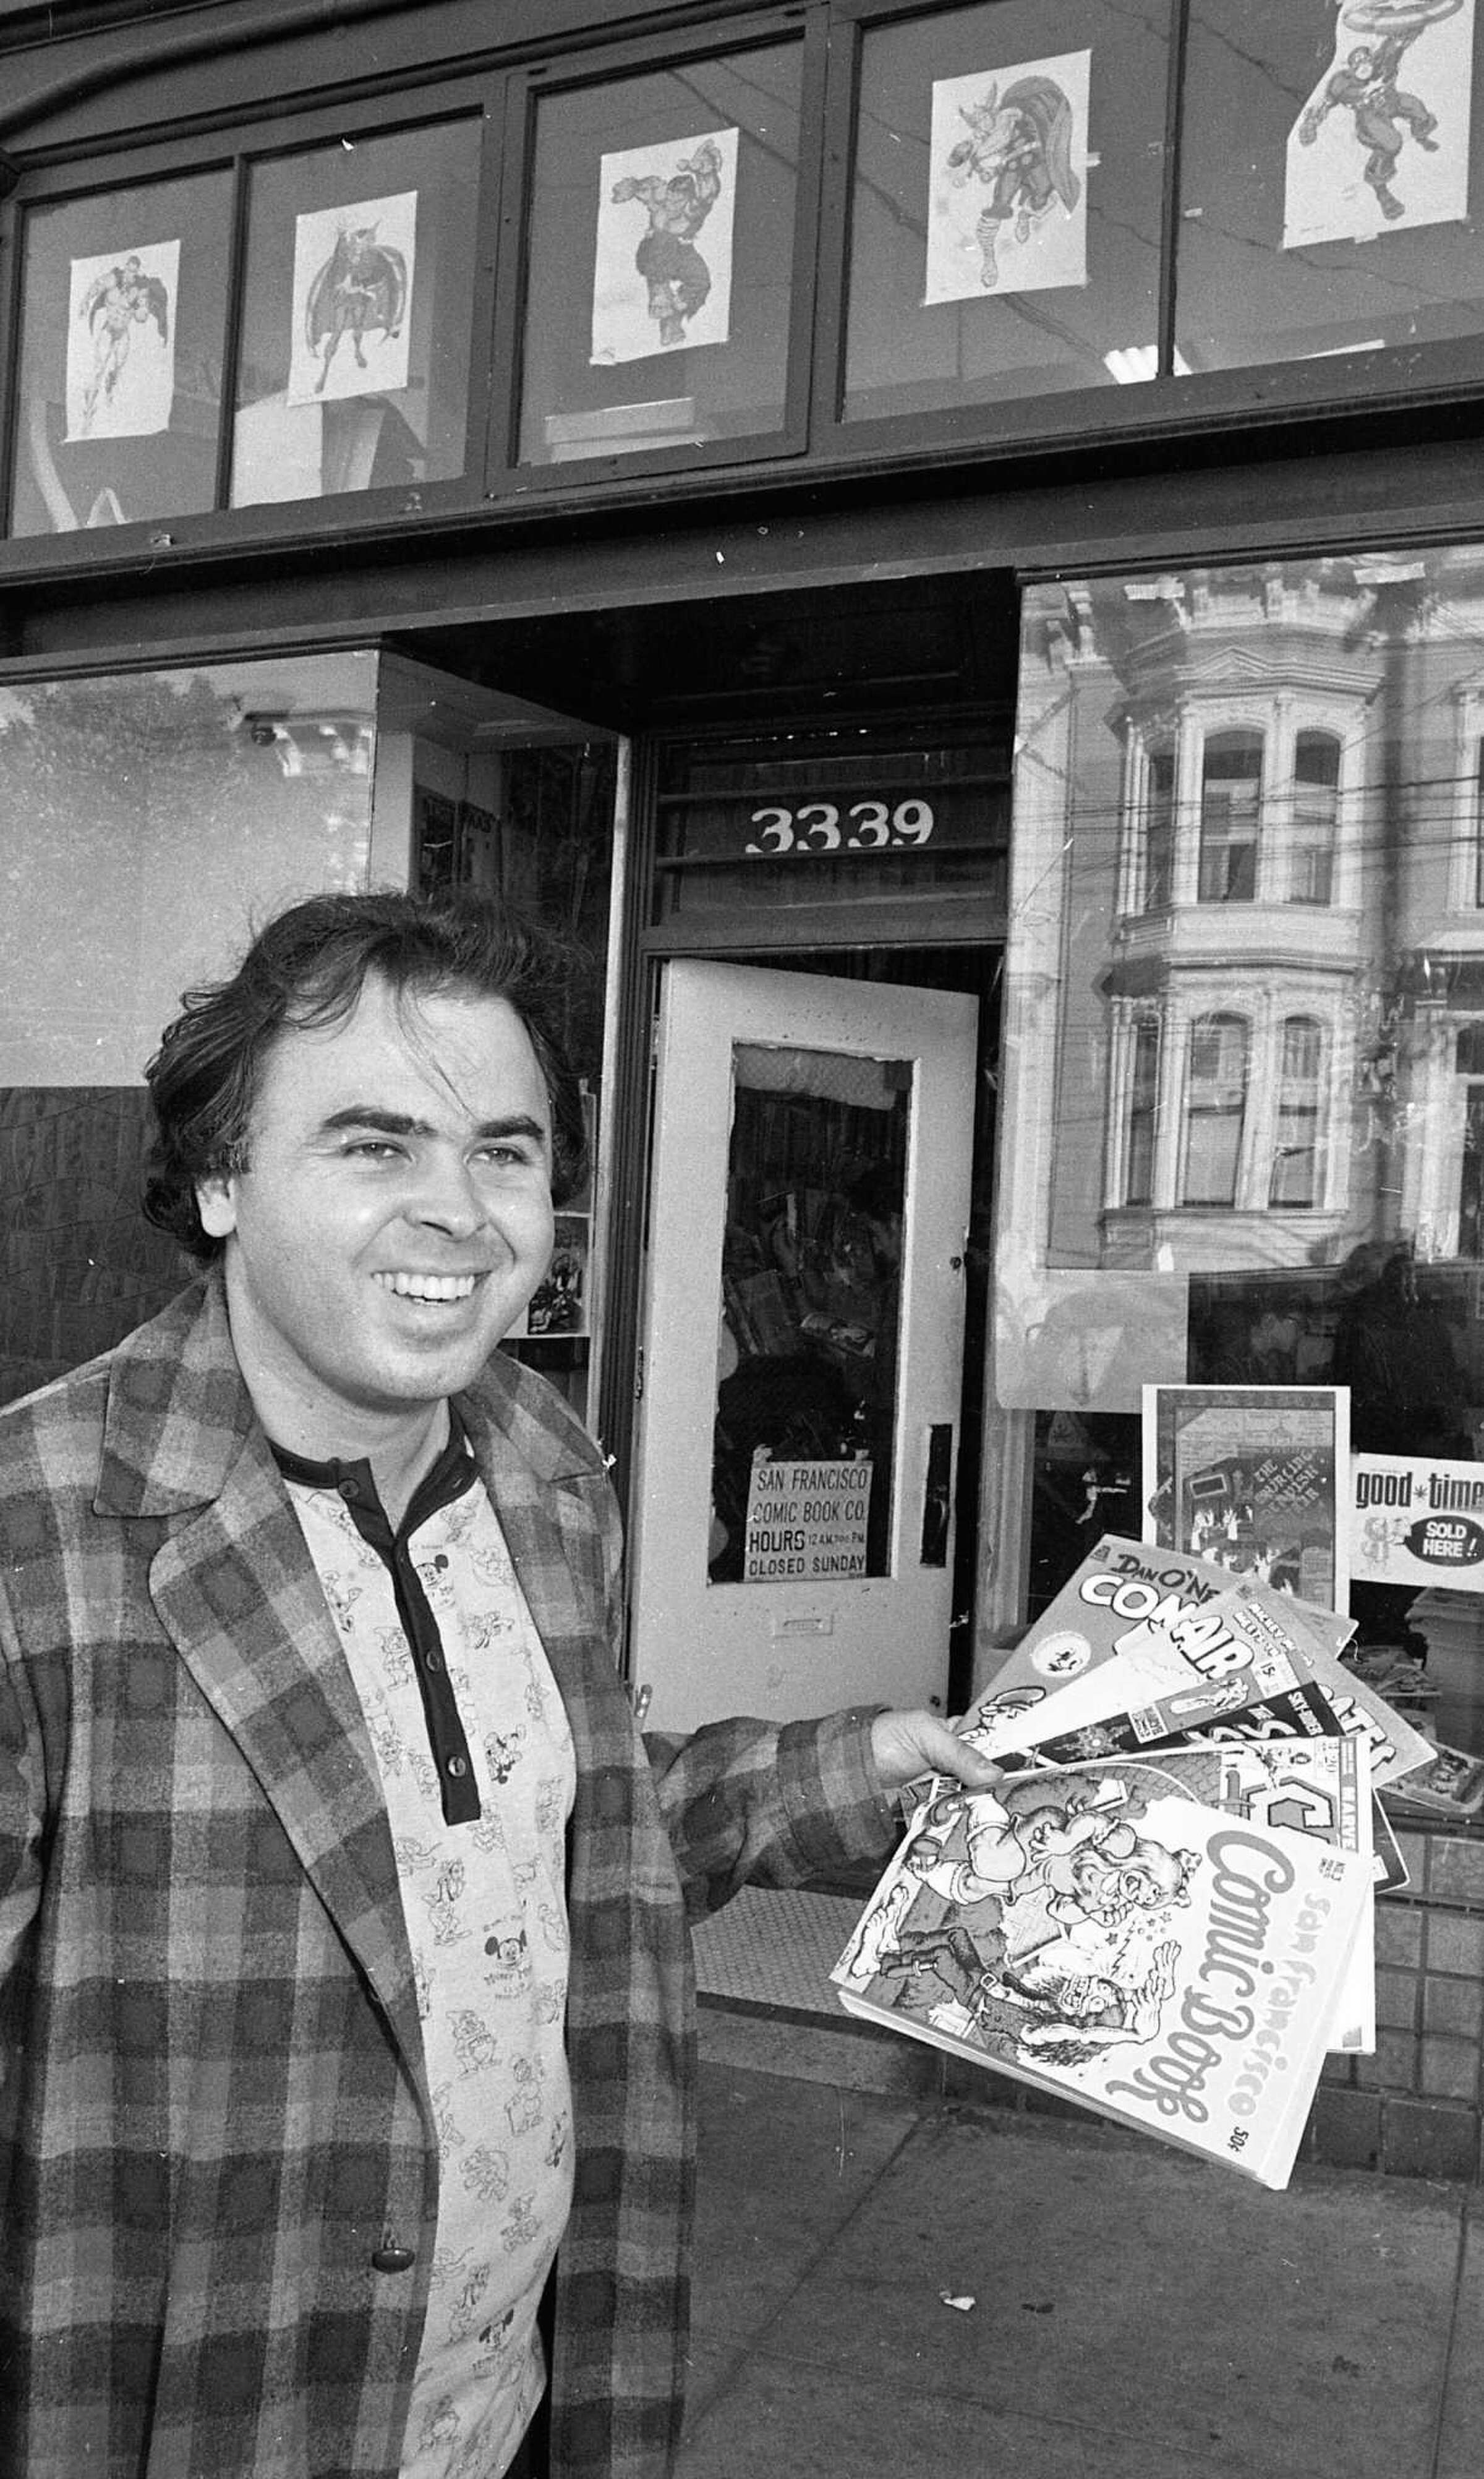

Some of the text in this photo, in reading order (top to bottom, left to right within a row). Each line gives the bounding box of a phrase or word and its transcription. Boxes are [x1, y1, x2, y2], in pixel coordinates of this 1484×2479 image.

[745, 799, 934, 853] 3339
[757, 1467, 868, 1491] SAN FRANCISCO
[1355, 1471, 1413, 1509] good
[753, 1501, 798, 1524] COMIC
[804, 1500, 840, 1522] BOOK
[749, 1530, 805, 1553] HOURS
[1425, 1521, 1467, 1540] SOLD
[1422, 1538, 1463, 1557] HERE
[749, 1555, 866, 1576] CLOSED SUNDAY
[1198, 1830, 1295, 1998] Comic
[1105, 1985, 1255, 2123] Book
